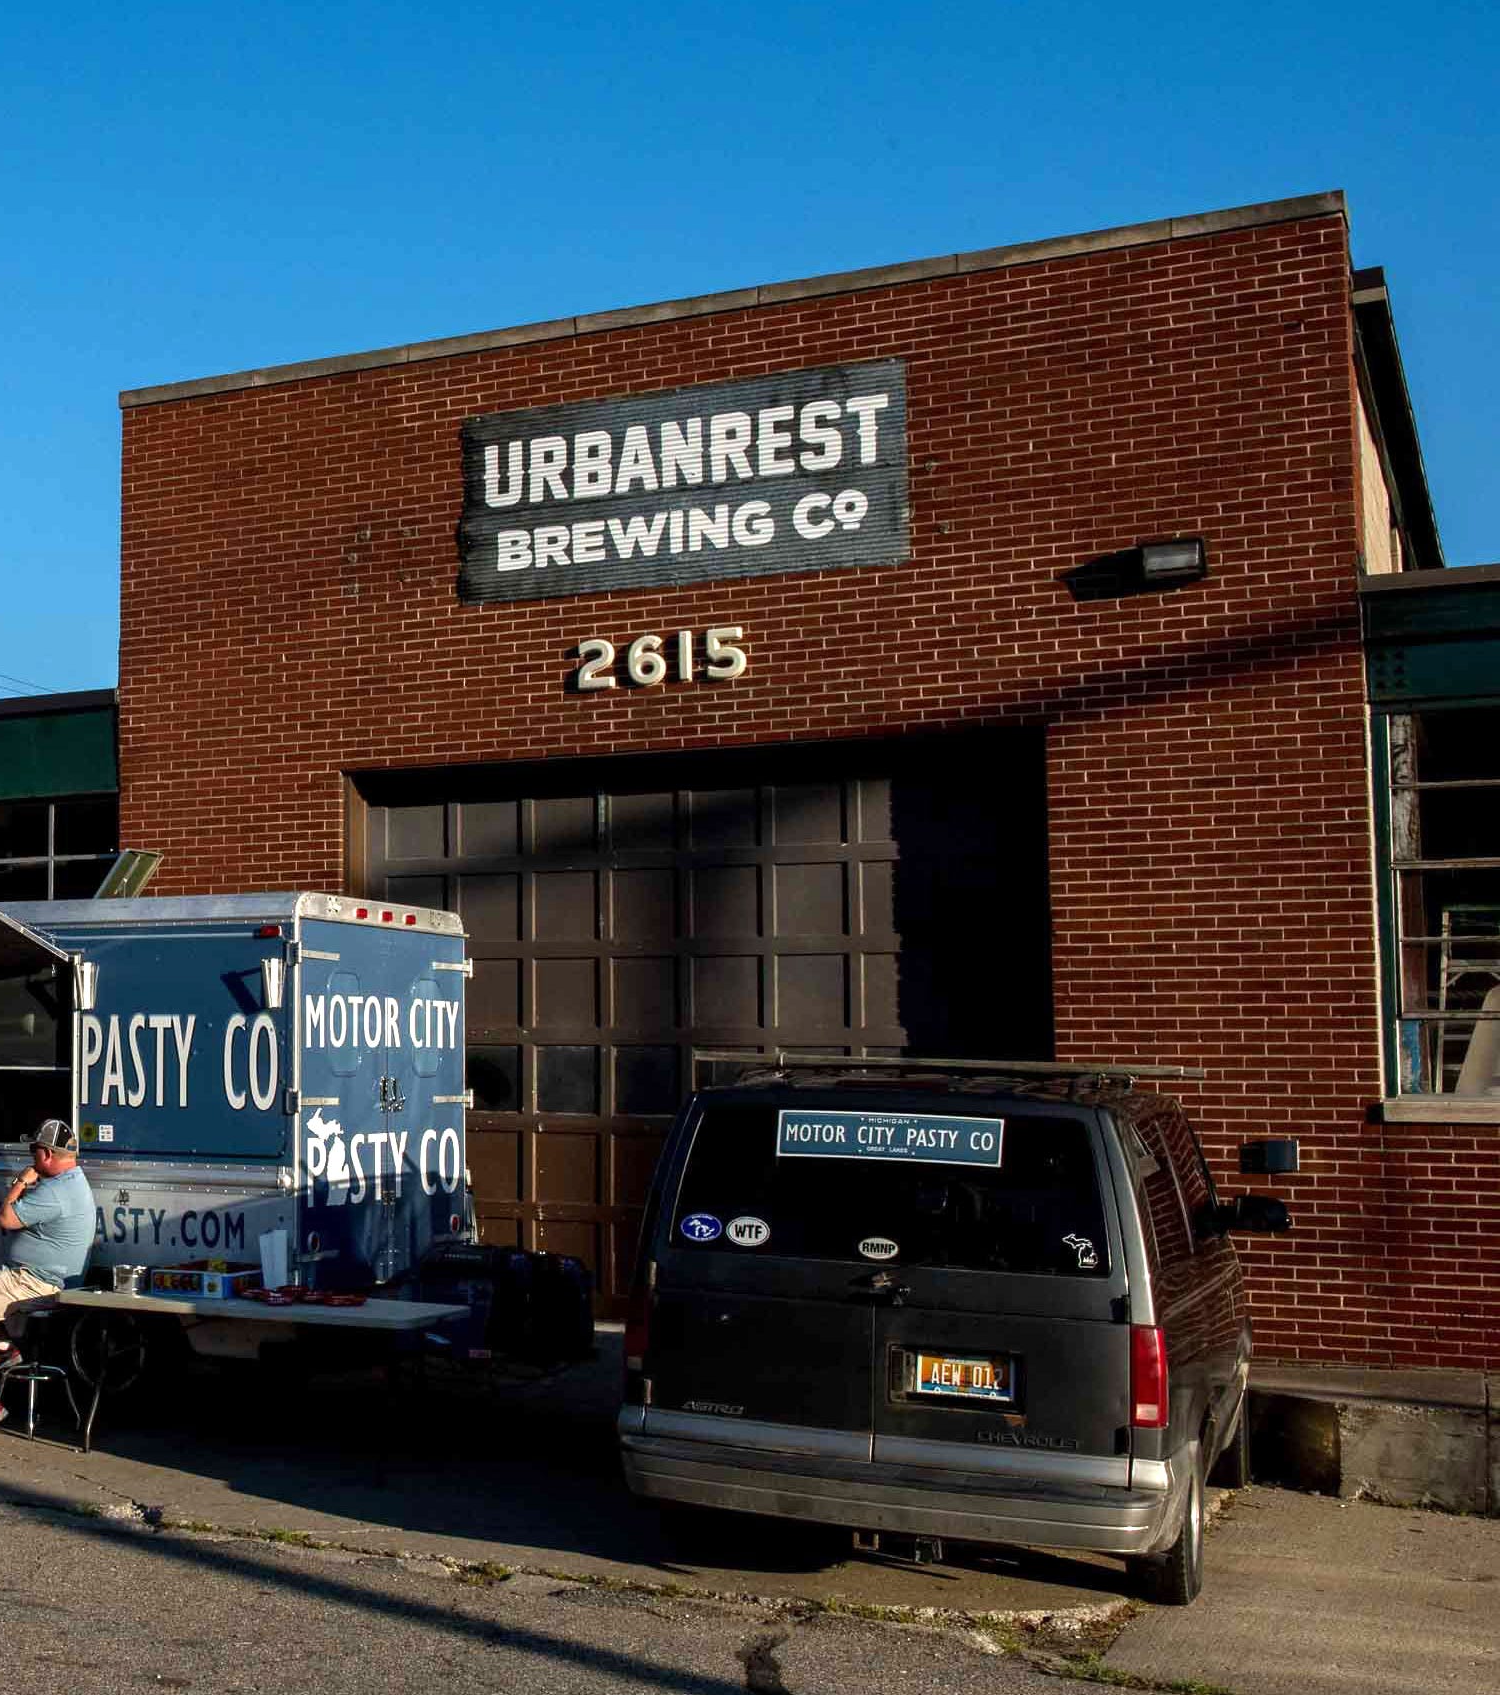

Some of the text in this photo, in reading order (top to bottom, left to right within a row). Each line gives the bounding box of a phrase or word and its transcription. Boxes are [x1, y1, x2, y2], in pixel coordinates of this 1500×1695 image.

[482, 393, 890, 509] URBANREST
[496, 500, 776, 572] BREWING
[576, 626, 748, 692] 2615
[304, 994, 460, 1050] MOTOR CITY
[80, 1012, 279, 1111] PASTY CO
[785, 1123, 994, 1151] MOTOR CITY PASTY CO
[867, 1117, 911, 1125] MICHIGAN
[419, 1127, 460, 1197] CO
[733, 1223, 763, 1240] WTF
[862, 1241, 897, 1255] RMNP
